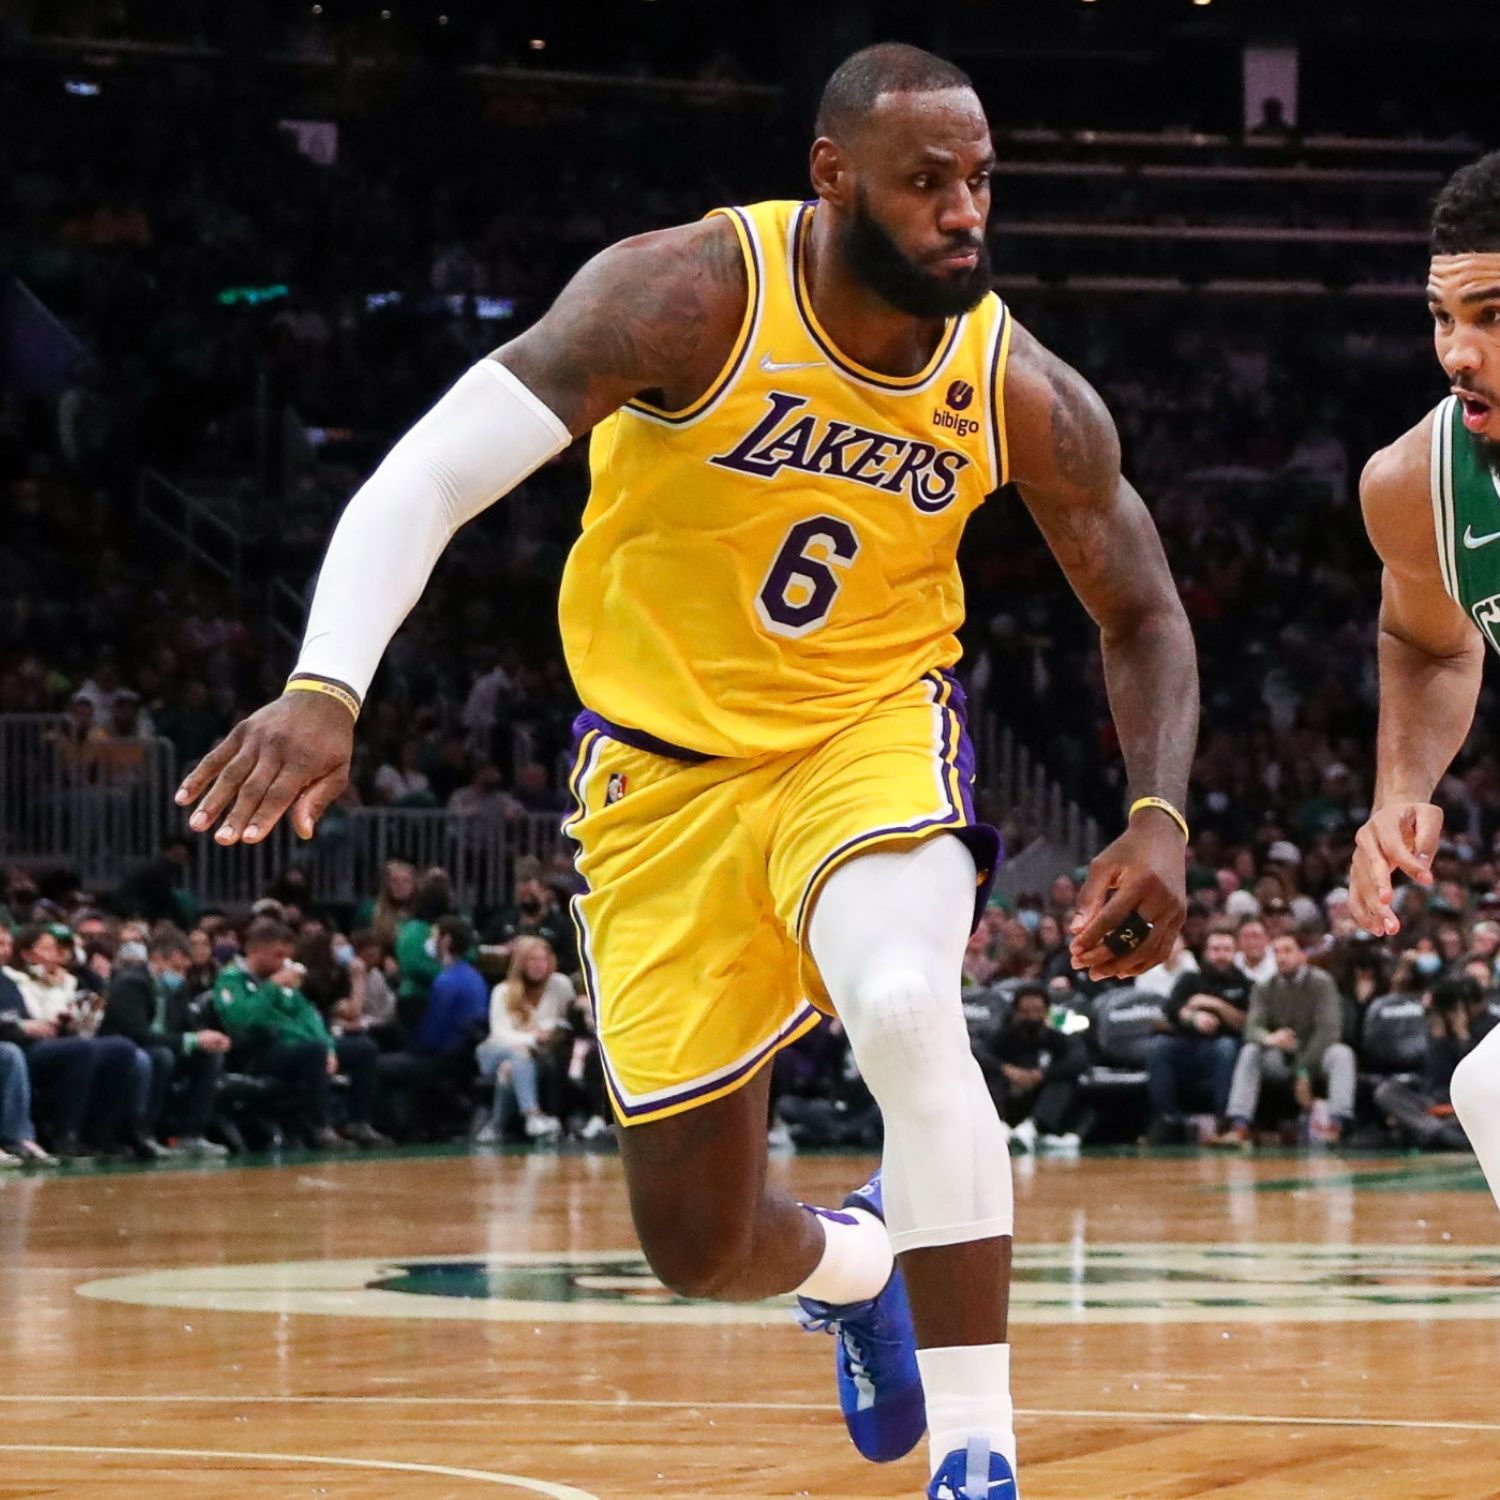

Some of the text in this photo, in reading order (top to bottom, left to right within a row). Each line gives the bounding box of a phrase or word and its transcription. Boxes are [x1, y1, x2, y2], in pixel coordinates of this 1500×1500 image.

[706, 389, 972, 516] LAKERS
[931, 408, 980, 437] bibigo
[753, 514, 862, 640] 6
